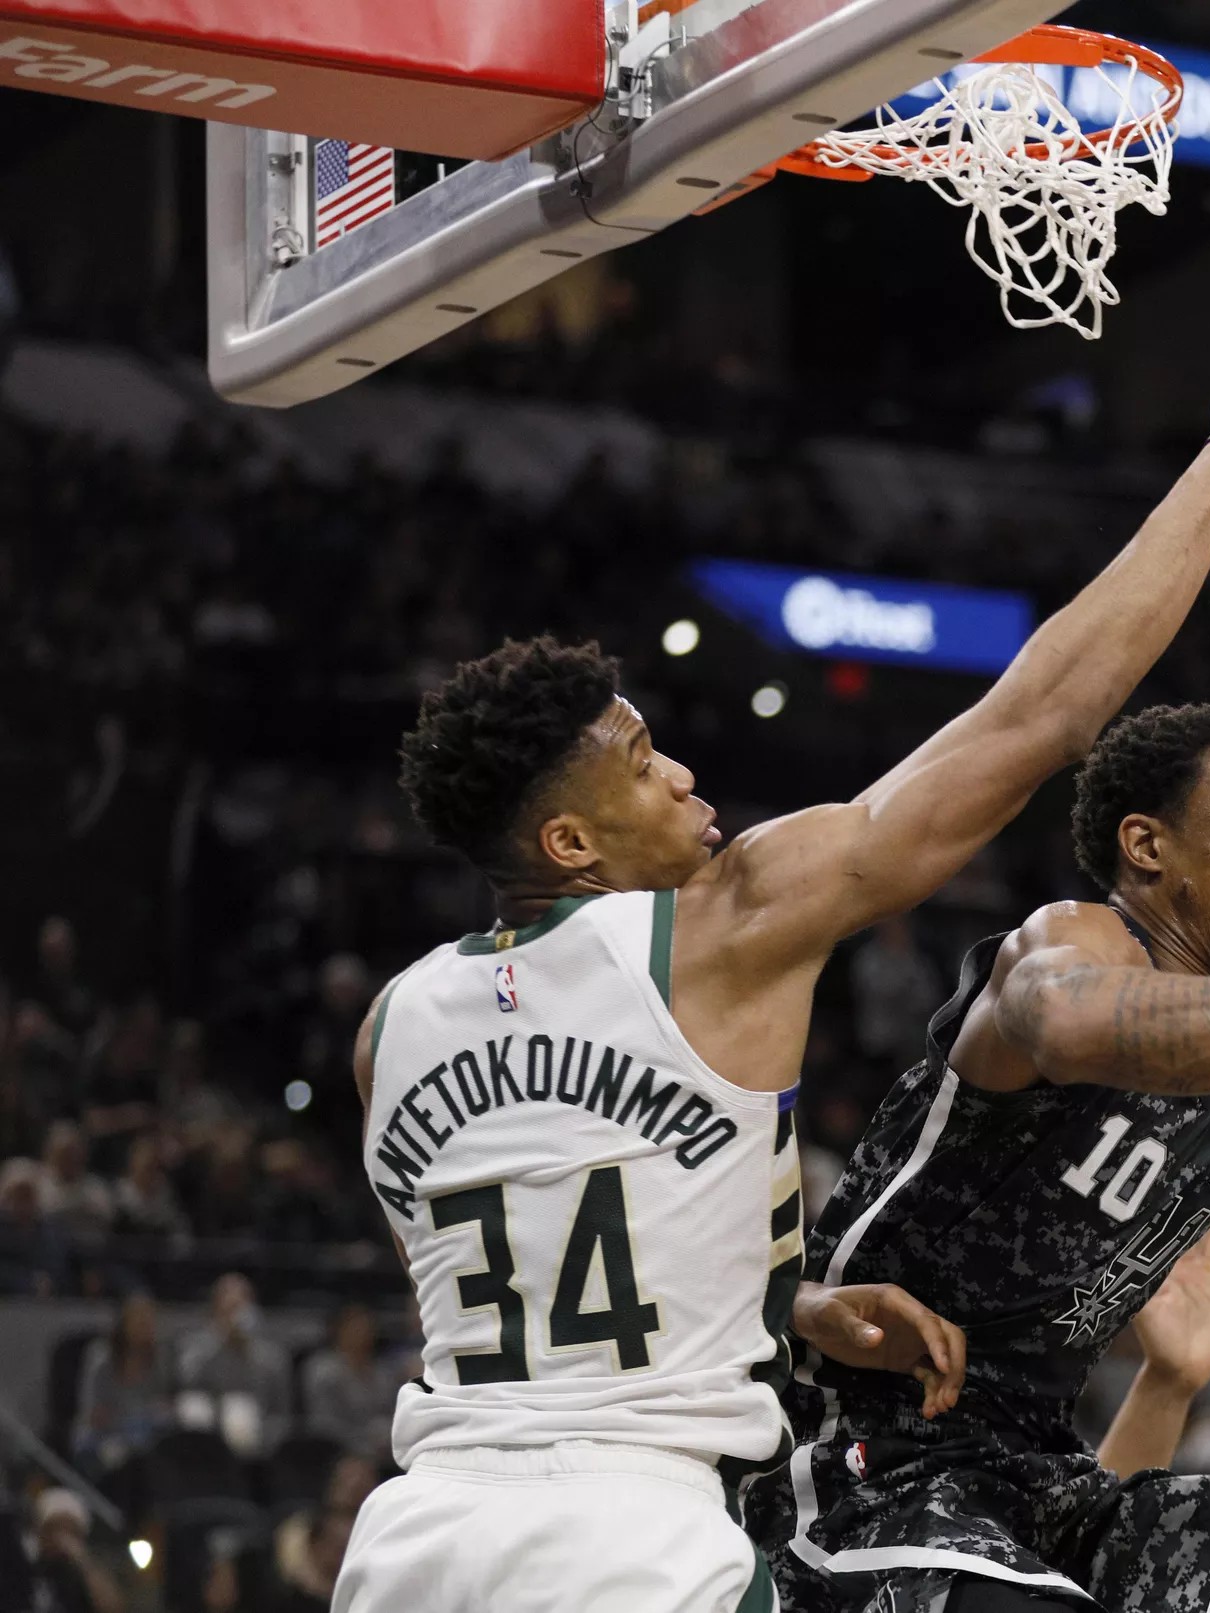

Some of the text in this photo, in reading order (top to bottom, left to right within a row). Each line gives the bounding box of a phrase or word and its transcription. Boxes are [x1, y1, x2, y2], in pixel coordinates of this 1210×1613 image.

[0, 36, 277, 109] Farm
[374, 1034, 738, 1223] ANTETOKOUNMPO
[1059, 1113, 1168, 1223] 10
[428, 1161, 668, 1386] 34
